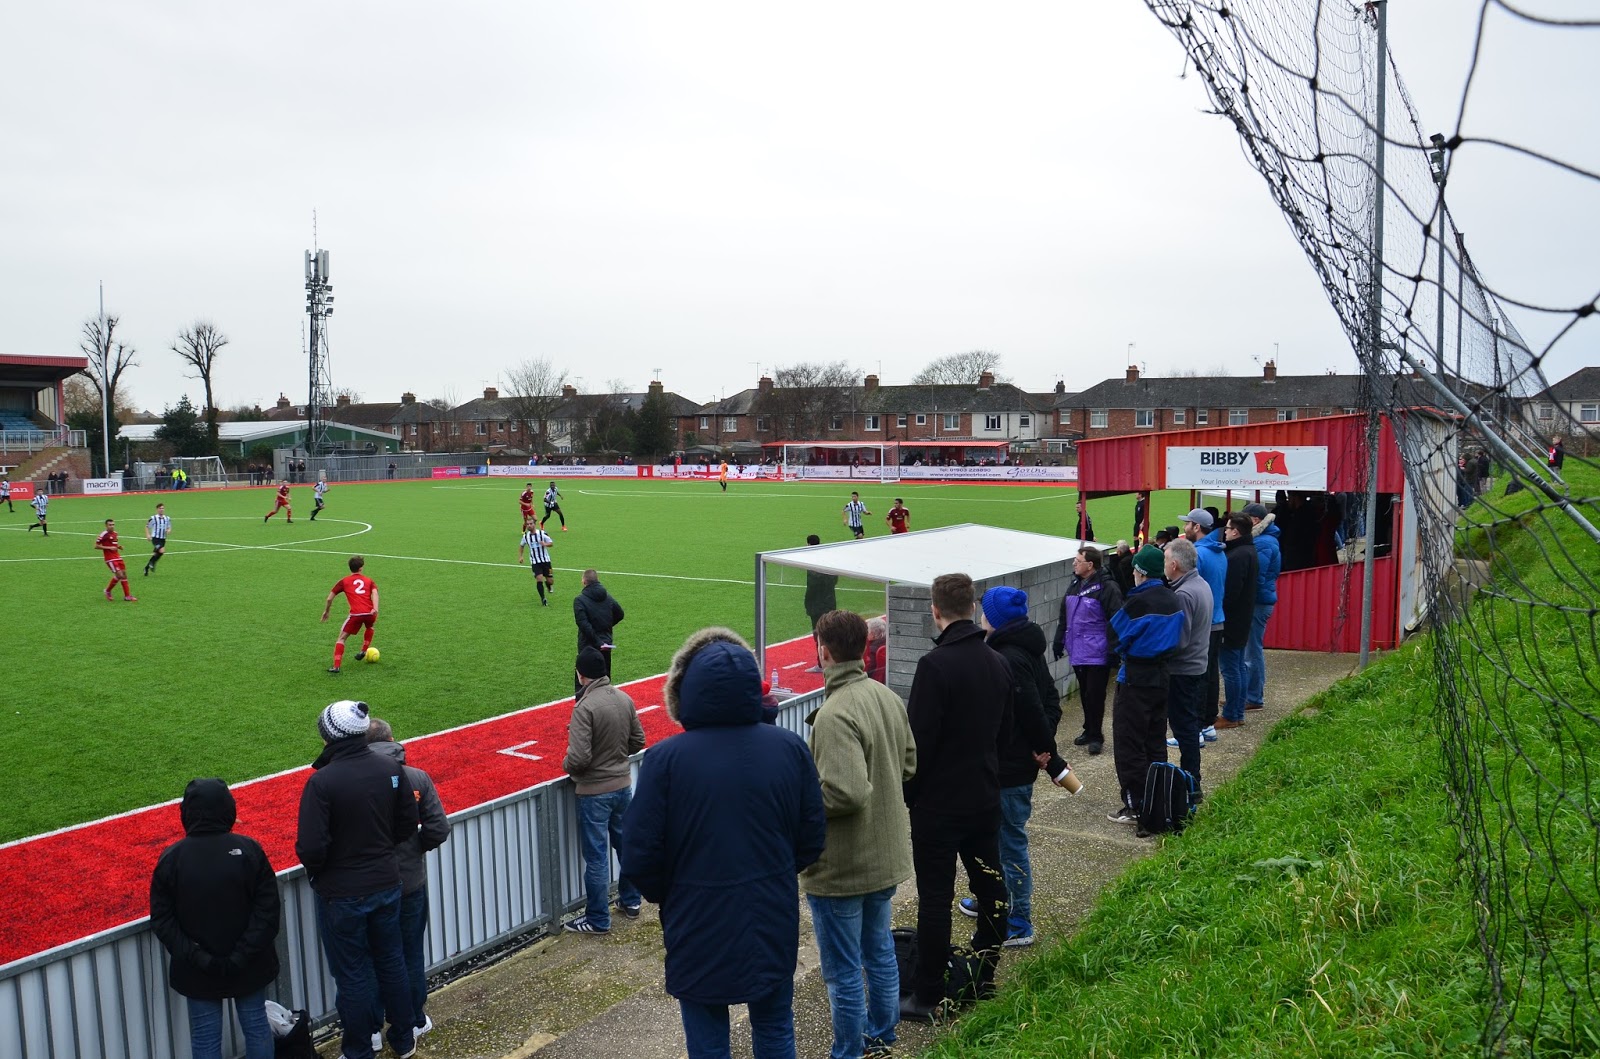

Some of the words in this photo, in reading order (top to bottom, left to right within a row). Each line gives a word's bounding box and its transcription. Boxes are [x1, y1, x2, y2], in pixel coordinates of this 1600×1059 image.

[1200, 451, 1250, 465] BIBBY
[1006, 467, 1047, 478] Goring
[86, 480, 119, 489] macron
[352, 578, 366, 595] 2
